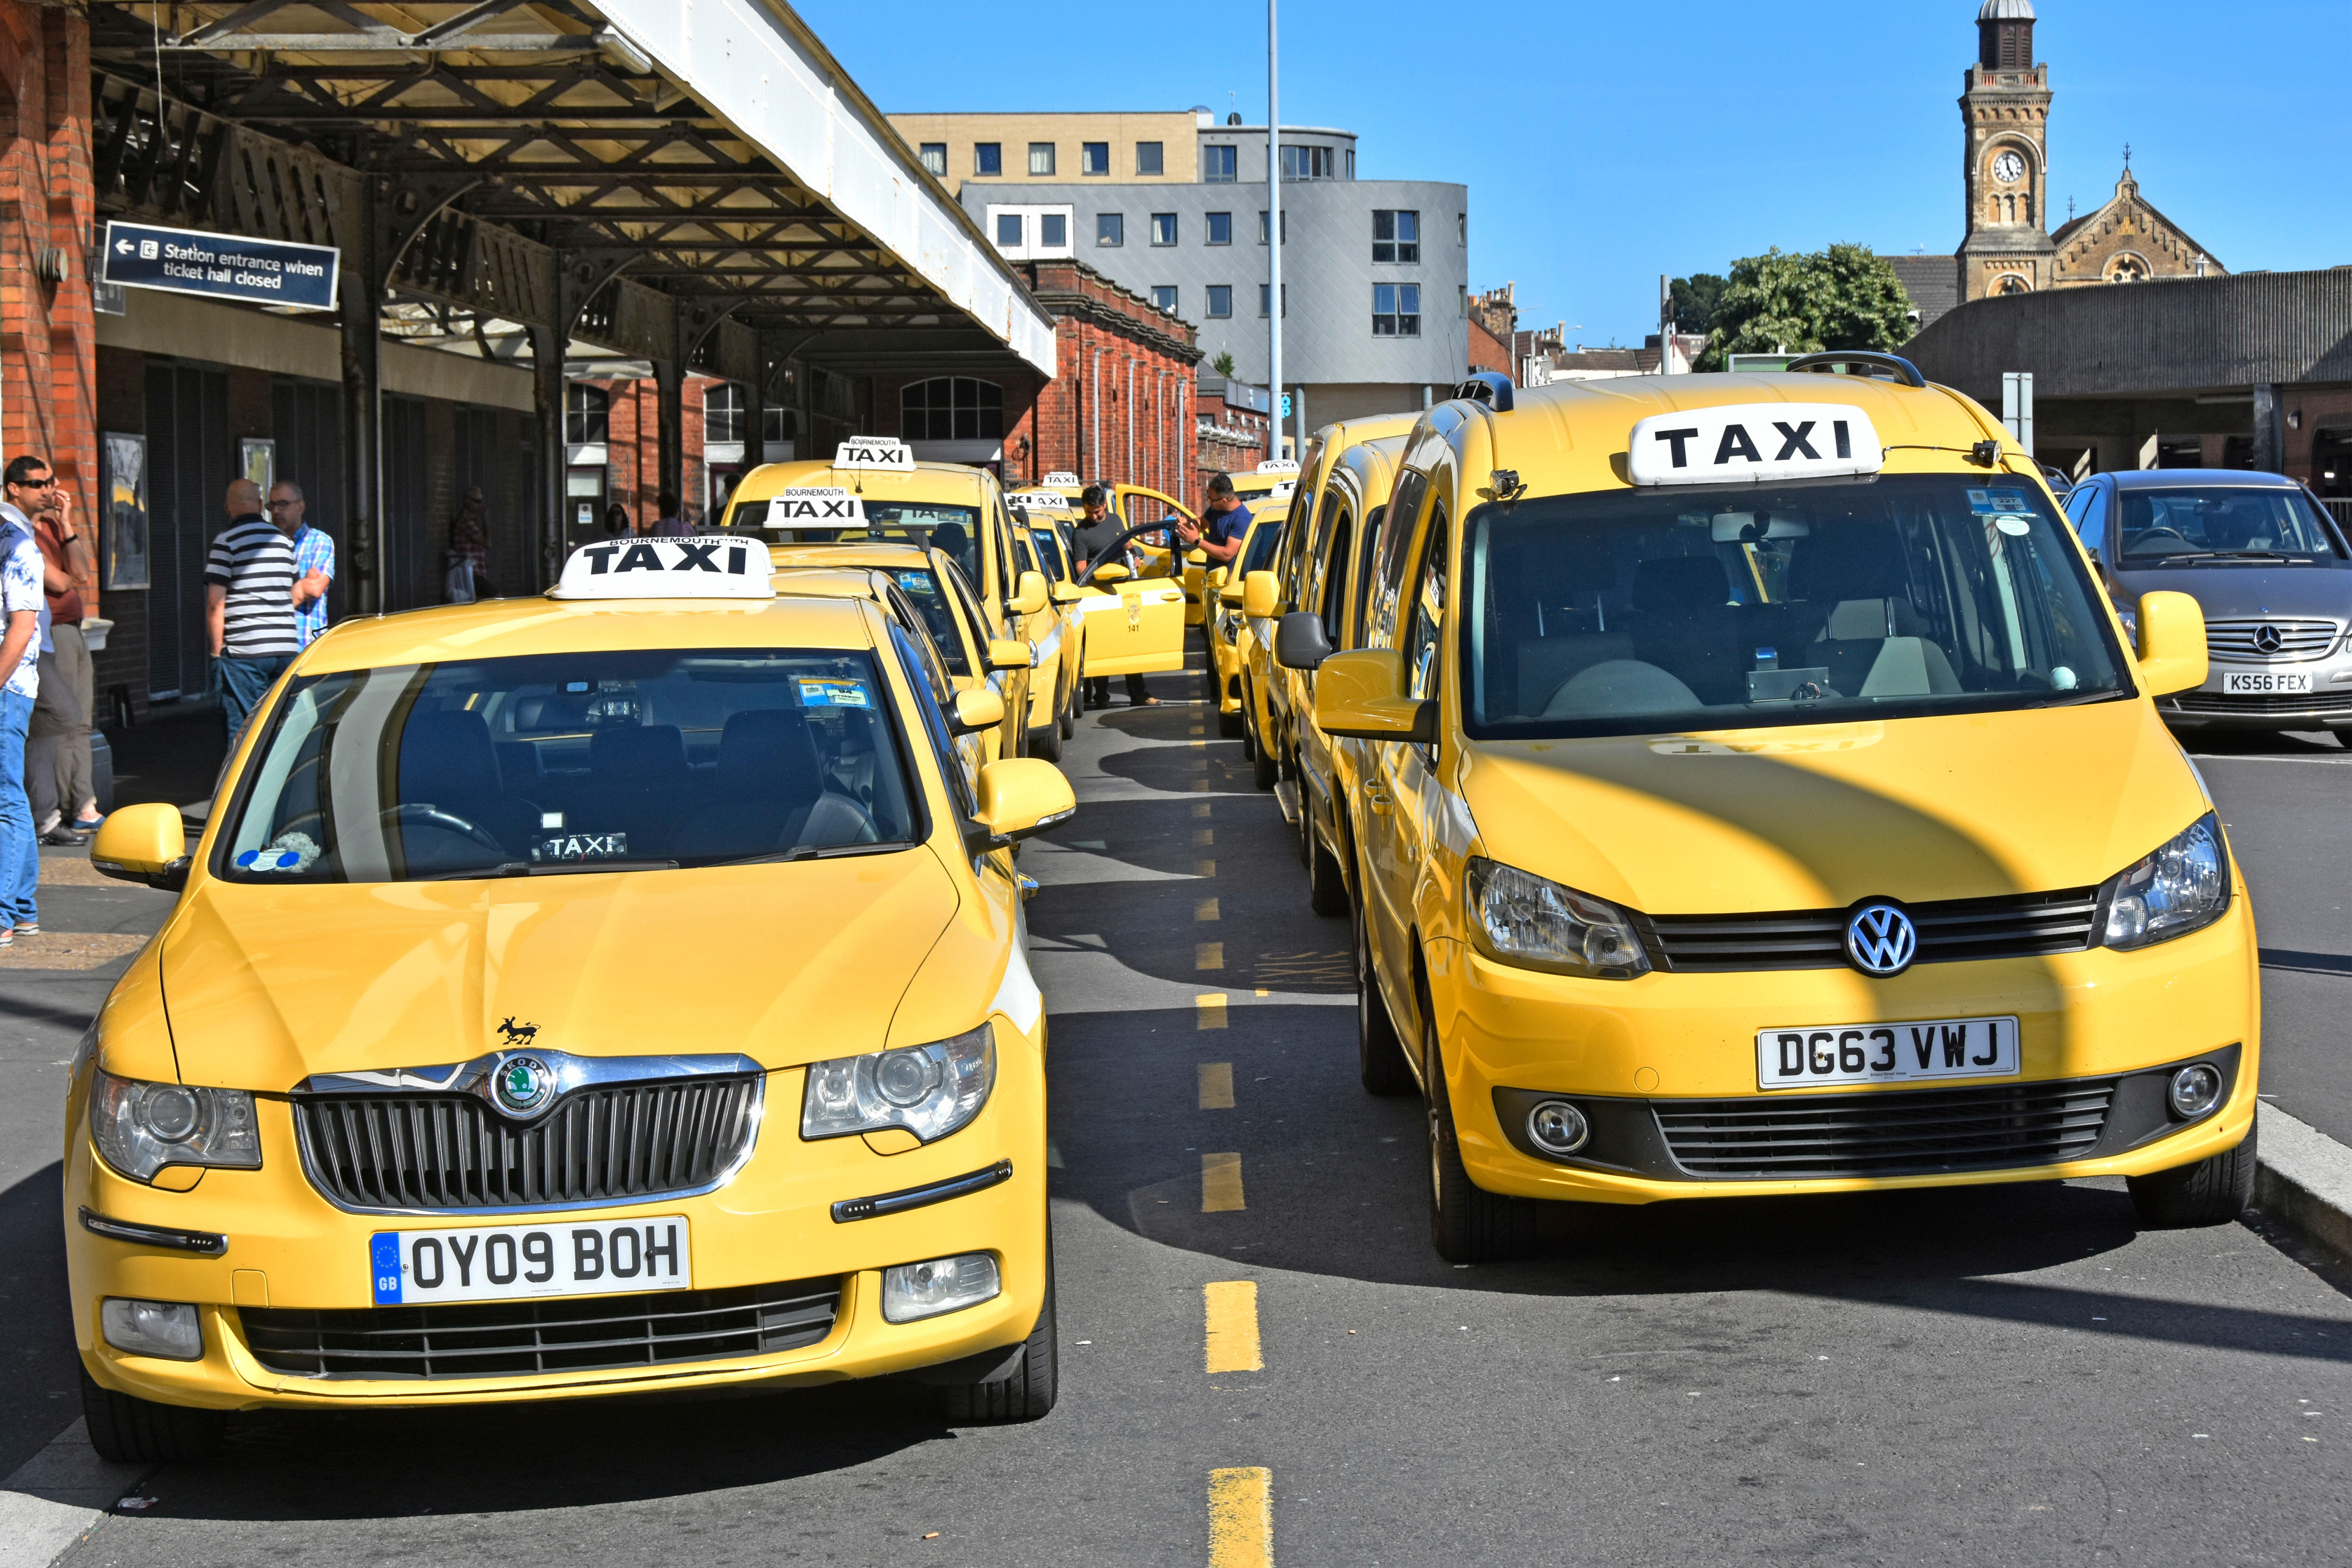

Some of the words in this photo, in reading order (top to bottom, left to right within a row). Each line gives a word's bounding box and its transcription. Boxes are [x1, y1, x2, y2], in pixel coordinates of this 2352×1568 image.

[165, 243, 215, 263] Station
[219, 253, 281, 271] entrance
[285, 260, 323, 277] when
[164, 262, 203, 280] ticket
[207, 266, 231, 283] hall
[235, 271, 282, 289] closed
[1655, 420, 1851, 469] TAXI
[842, 447, 903, 463] TAXI
[776, 501, 854, 518] TAXI
[609, 537, 720, 546] BOURNEMOUTH
[583, 543, 747, 575] TAXI
[2231, 675, 2273, 690] KS56
[2278, 675, 2306, 690] FEX
[549, 837, 613, 855] TAXI
[1778, 1029, 1895, 1076] DG63
[1911, 1023, 1997, 1069] VWJ
[500, 1058, 544, 1077] SKODA
[412, 1231, 554, 1289] OY09
[572, 1225, 679, 1280] BOH
[379, 1276, 397, 1291] GB
